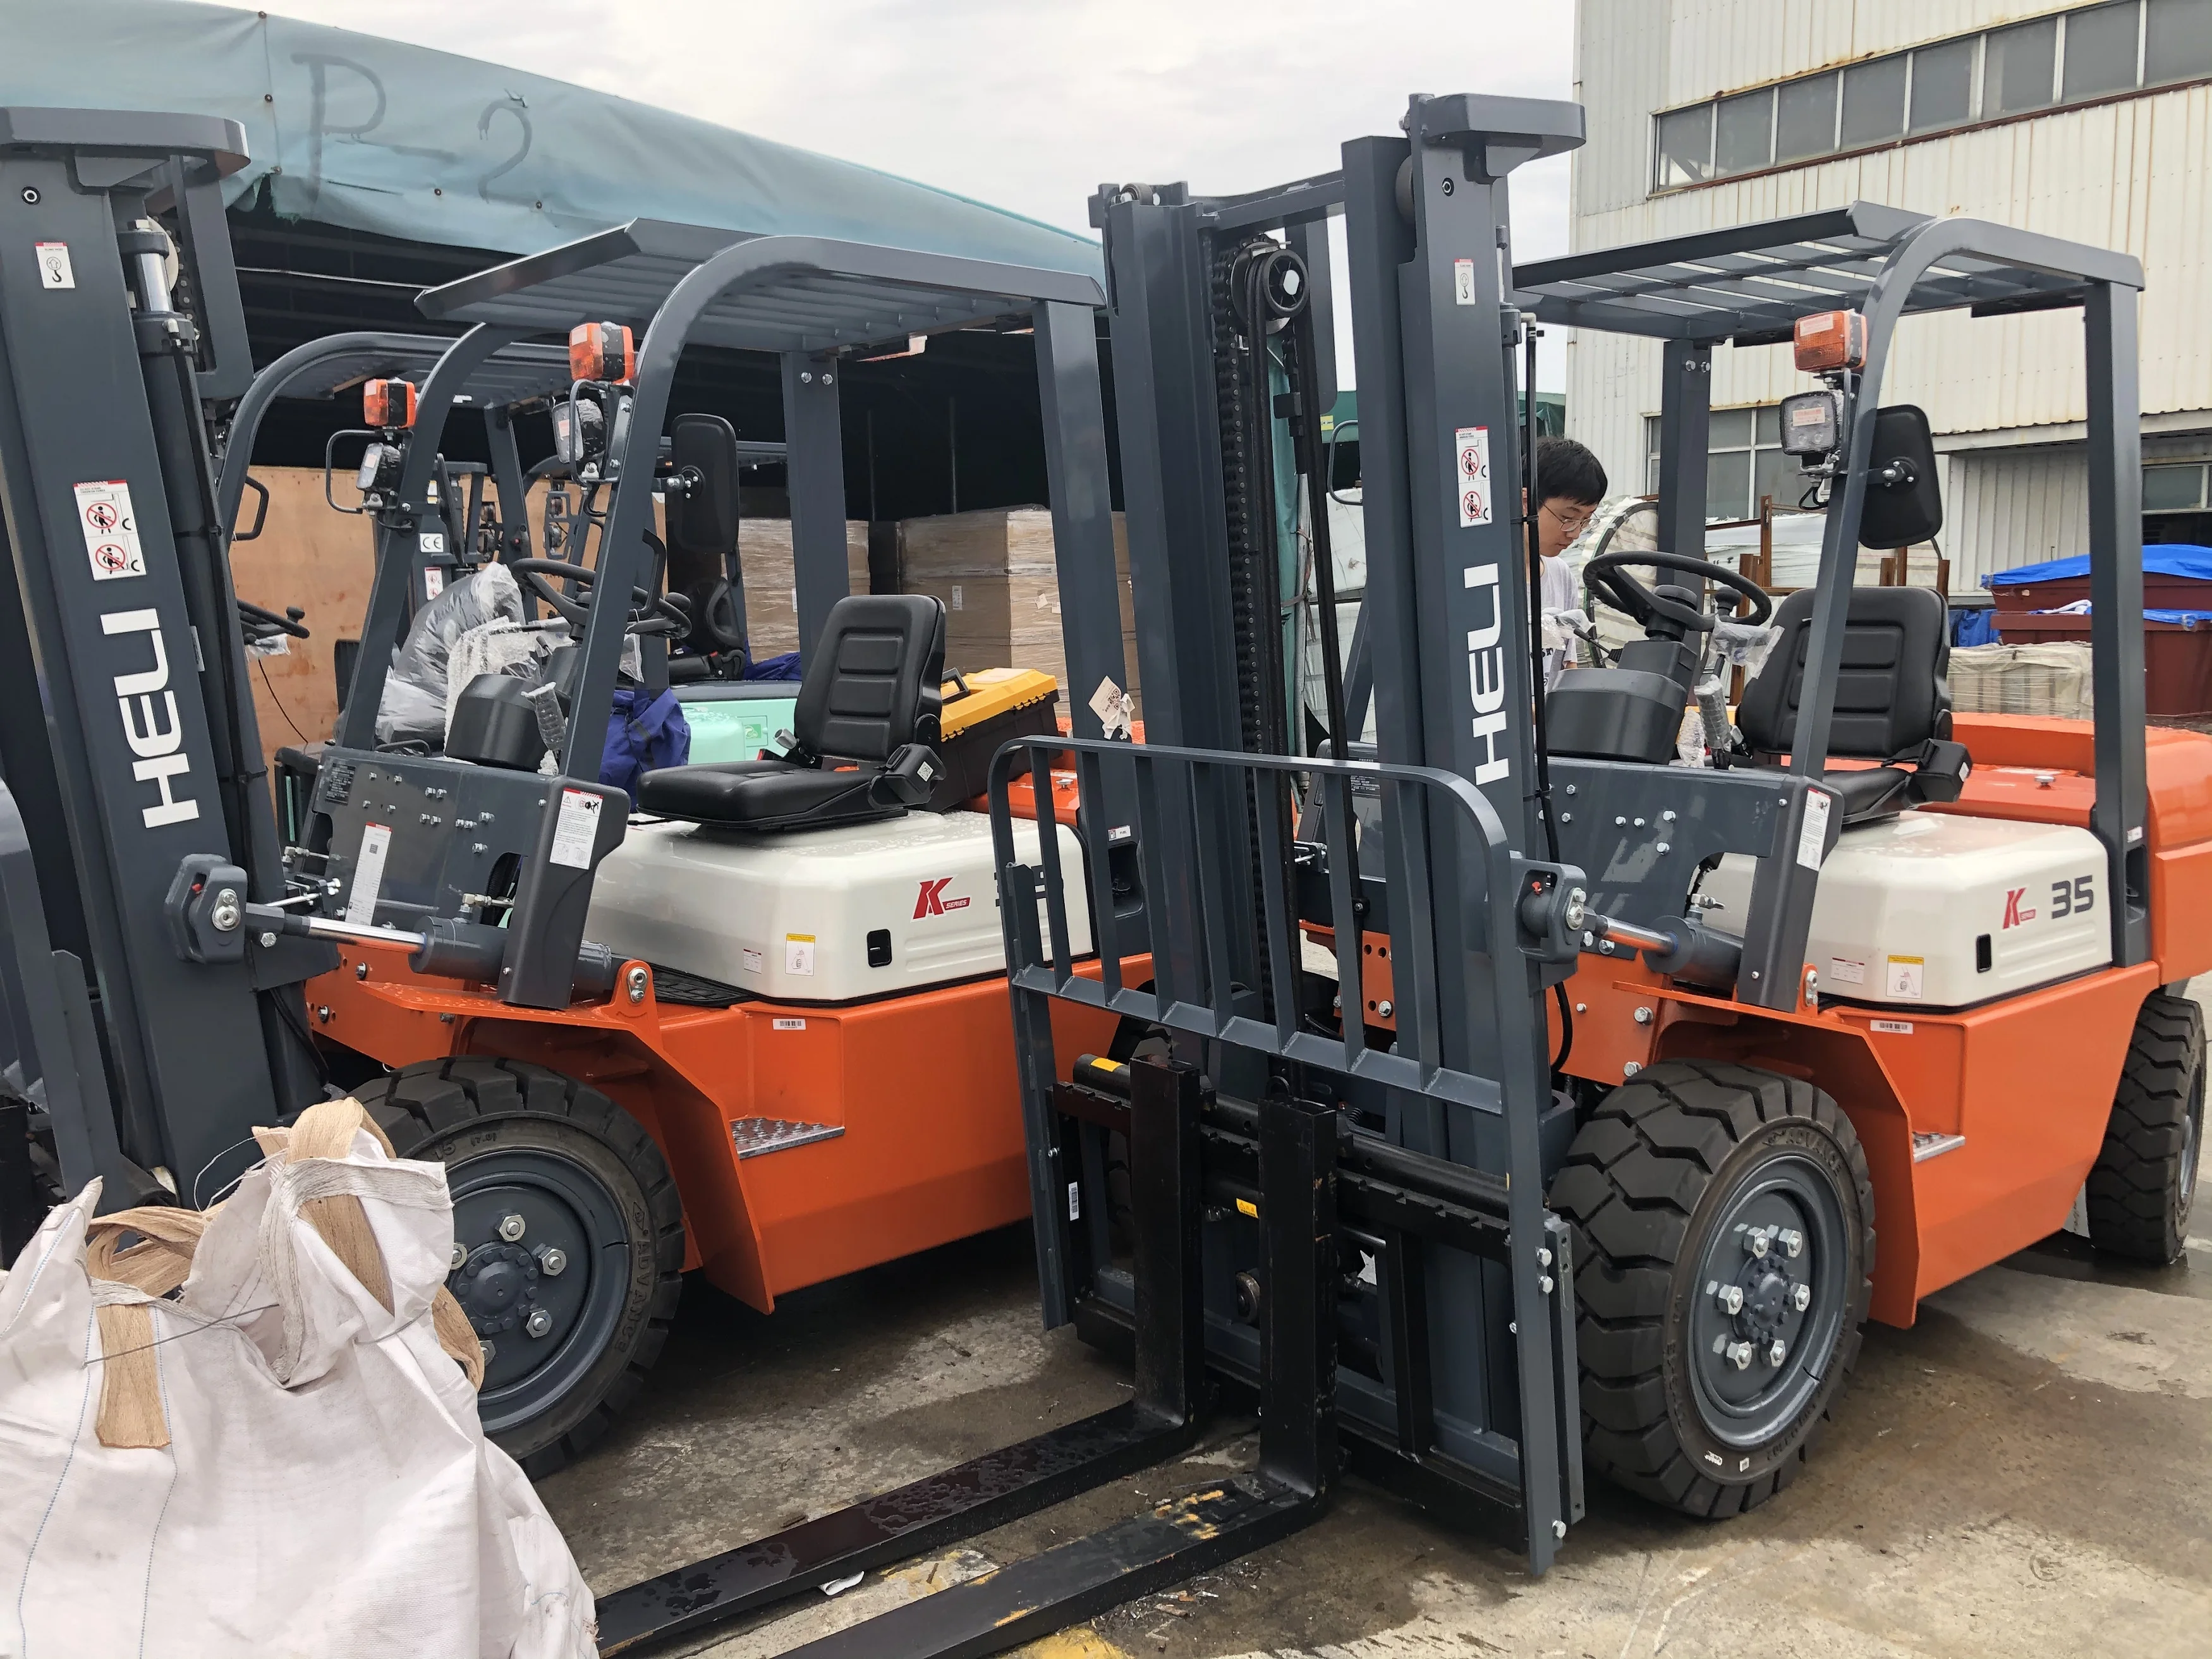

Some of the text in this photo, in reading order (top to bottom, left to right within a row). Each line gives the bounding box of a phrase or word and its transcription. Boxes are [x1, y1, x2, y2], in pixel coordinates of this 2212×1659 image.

[423, 537, 441, 549] CE
[1464, 562, 1510, 786] HELI
[100, 608, 200, 829] HELI
[913, 877, 967, 920] K SERIES
[2003, 887, 2027, 930] K
[2051, 875, 2094, 920] 35
[1785, 1127, 1842, 1177] ADVANCE
[615, 1240, 651, 1353] ADVANCE
